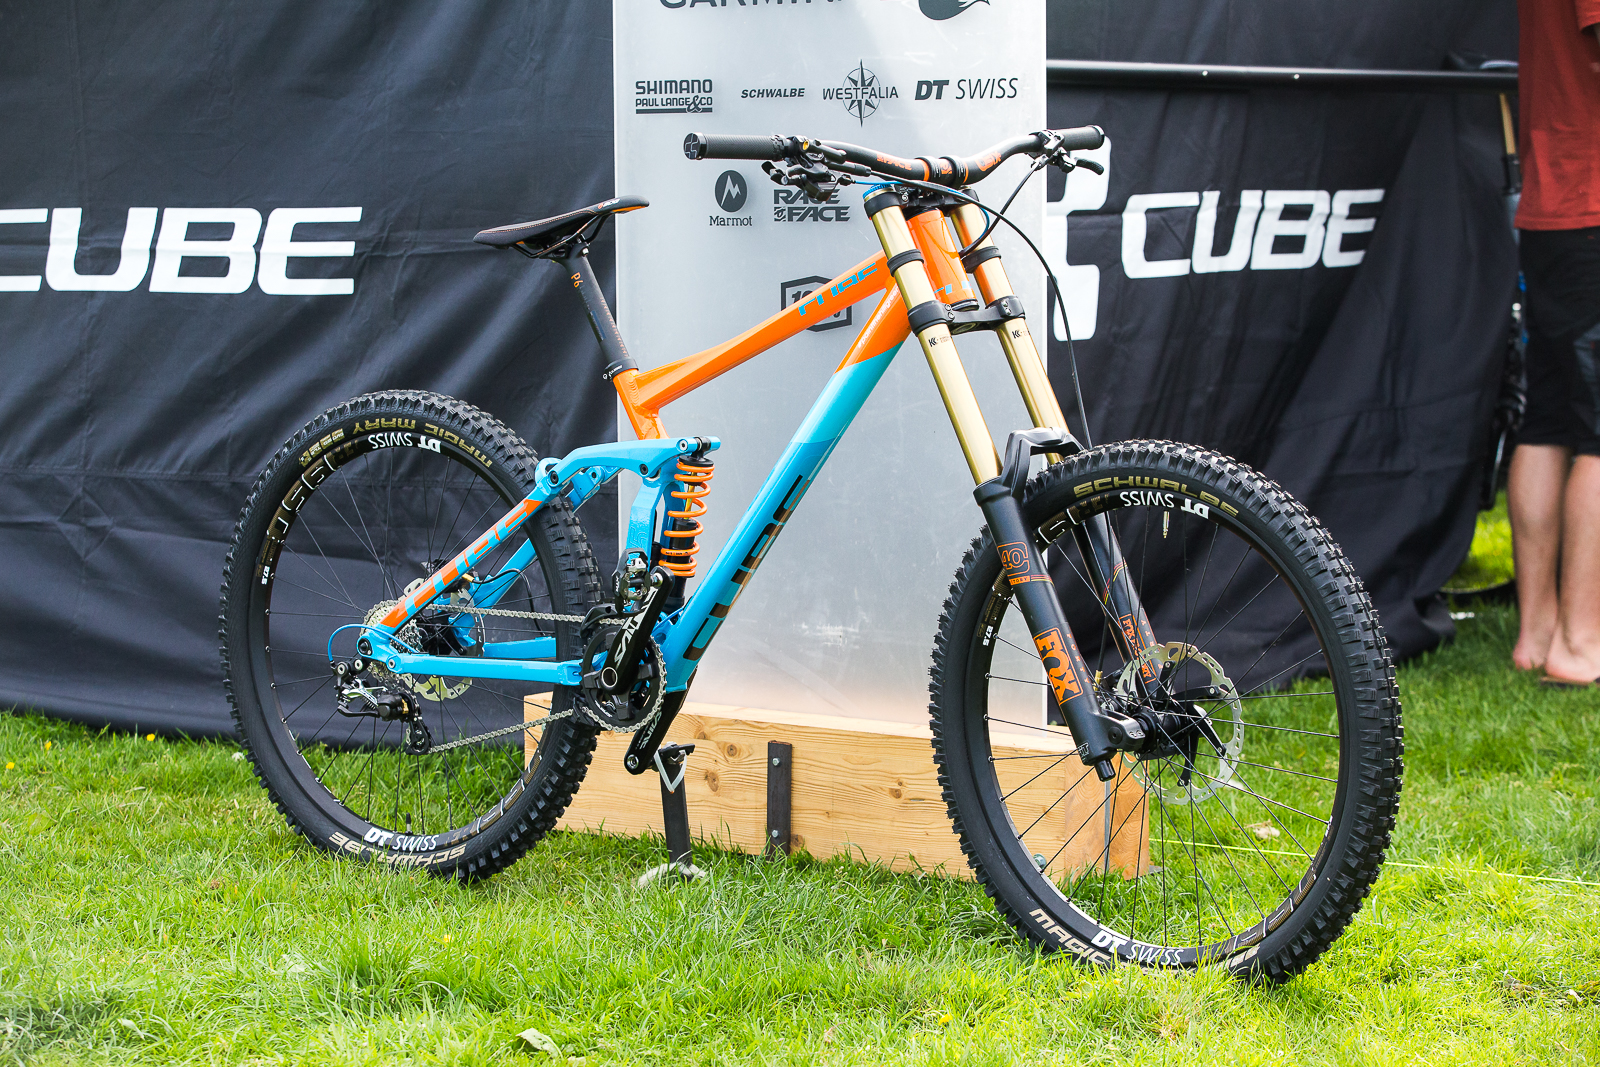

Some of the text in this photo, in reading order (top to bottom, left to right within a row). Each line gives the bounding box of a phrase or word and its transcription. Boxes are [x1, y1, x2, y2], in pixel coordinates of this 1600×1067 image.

[636, 79, 713, 95] SHIMANO
[741, 88, 805, 99] SCHWALBE
[823, 87, 899, 100] WESTFALIA
[915, 78, 1018, 100] DT SWISS
[636, 98, 660, 107] PAUL
[774, 189, 840, 204] RAE
[709, 215, 753, 227] Marmot
[1122, 188, 1385, 279] CUBE
[352, 417, 493, 468] MAGIC MARY
[367, 432, 414, 450] SWISS
[417, 435, 442, 454] DT
[1073, 475, 1239, 518] SCHWALBE
[1120, 490, 1211, 520] DT SWISS
[1001, 548, 1026, 570] 40
[1037, 629, 1082, 702] FOX
[1066, 633, 1090, 684] FORTY
[363, 826, 439, 852] DT SWISS
[1029, 908, 1111, 965] MAGIC
[1091, 930, 1128, 953] DT
[1126, 943, 1184, 966] SWISS
